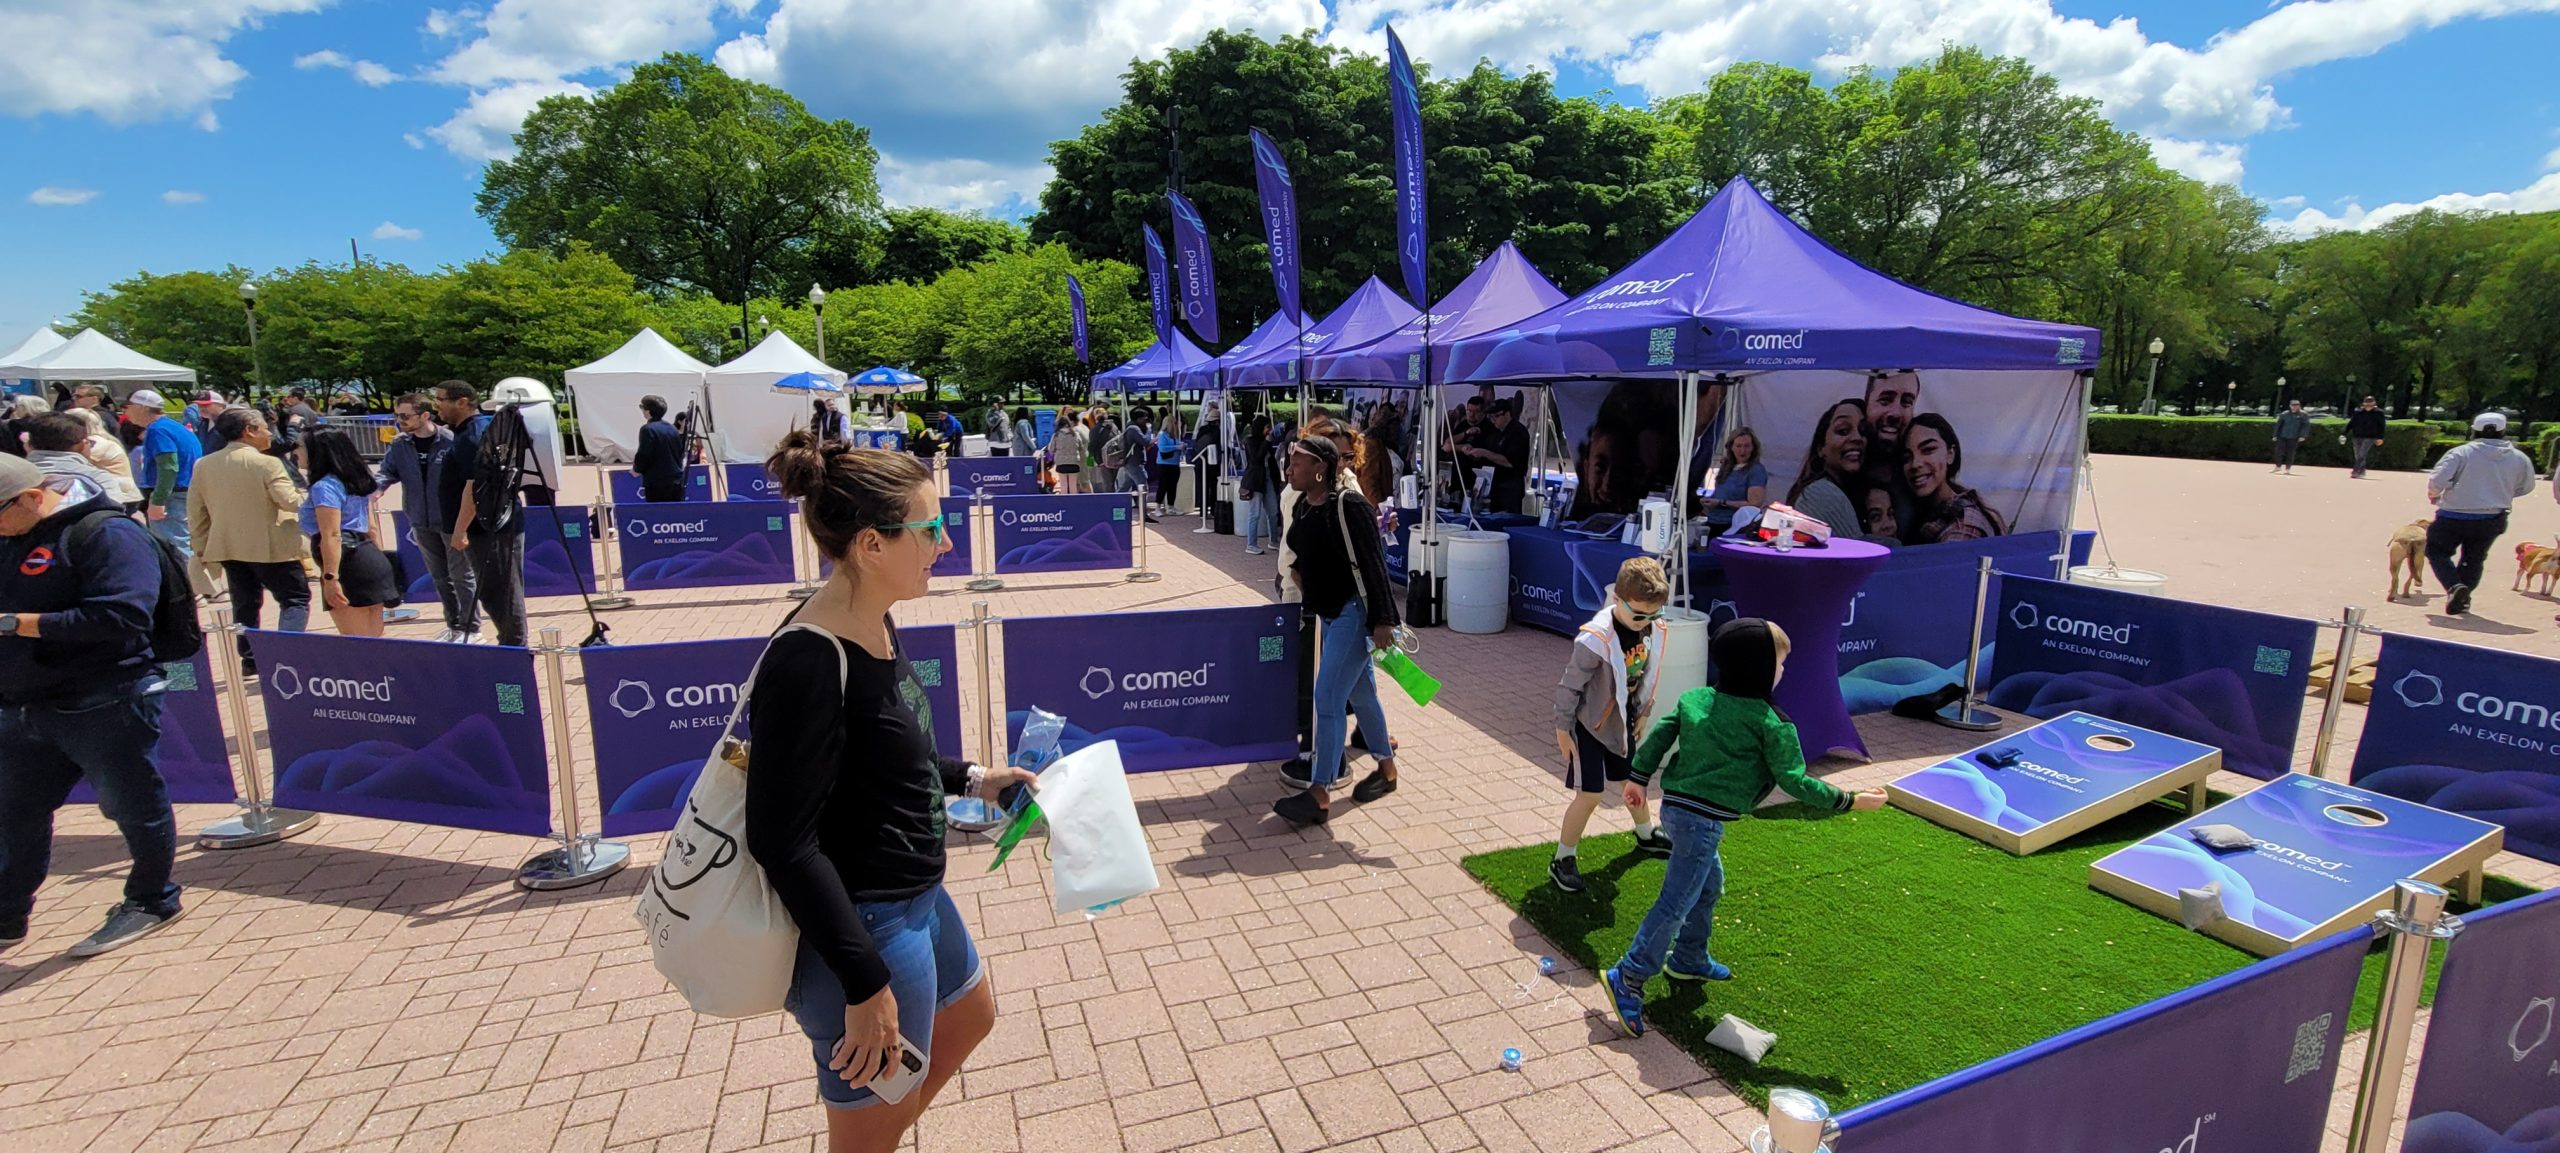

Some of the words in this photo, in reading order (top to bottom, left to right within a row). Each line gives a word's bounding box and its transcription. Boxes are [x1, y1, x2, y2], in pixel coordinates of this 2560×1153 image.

[1268, 207, 1284, 267] comed
[1184, 250, 1200, 297] comed
[1151, 272, 1161, 311] comed
[1745, 328, 1804, 350] comed
[982, 473, 1010, 482] comed
[652, 519, 704, 534] comed
[1020, 510, 1063, 523] comed
[1522, 584, 1561, 605] comed
[2045, 615, 2131, 645] comed
[1836, 638, 1878, 654] MPANY
[2042, 638, 2057, 648] AN
[2058, 641, 2096, 656] EXELON
[2098, 650, 2151, 667] COMPANY
[308, 675, 391, 702] comed
[1122, 662, 1208, 692] comed
[665, 682, 751, 708] com
[1122, 701, 1138, 711] AN
[1140, 698, 1180, 709] EXELON
[1182, 694, 1230, 706] COMPANY
[313, 708, 327, 718] AN
[328, 709, 366, 722] EXELON
[367, 712, 417, 726] COMPANY
[2456, 691, 2560, 732] come
[669, 718, 688, 731] AN
[2448, 722, 2472, 737] AN
[2476, 728, 2544, 752] EXELON
[2018, 761, 2085, 785] comed
[2047, 779, 2086, 794] COMPANY
[2296, 863, 2353, 885] COMPANY
